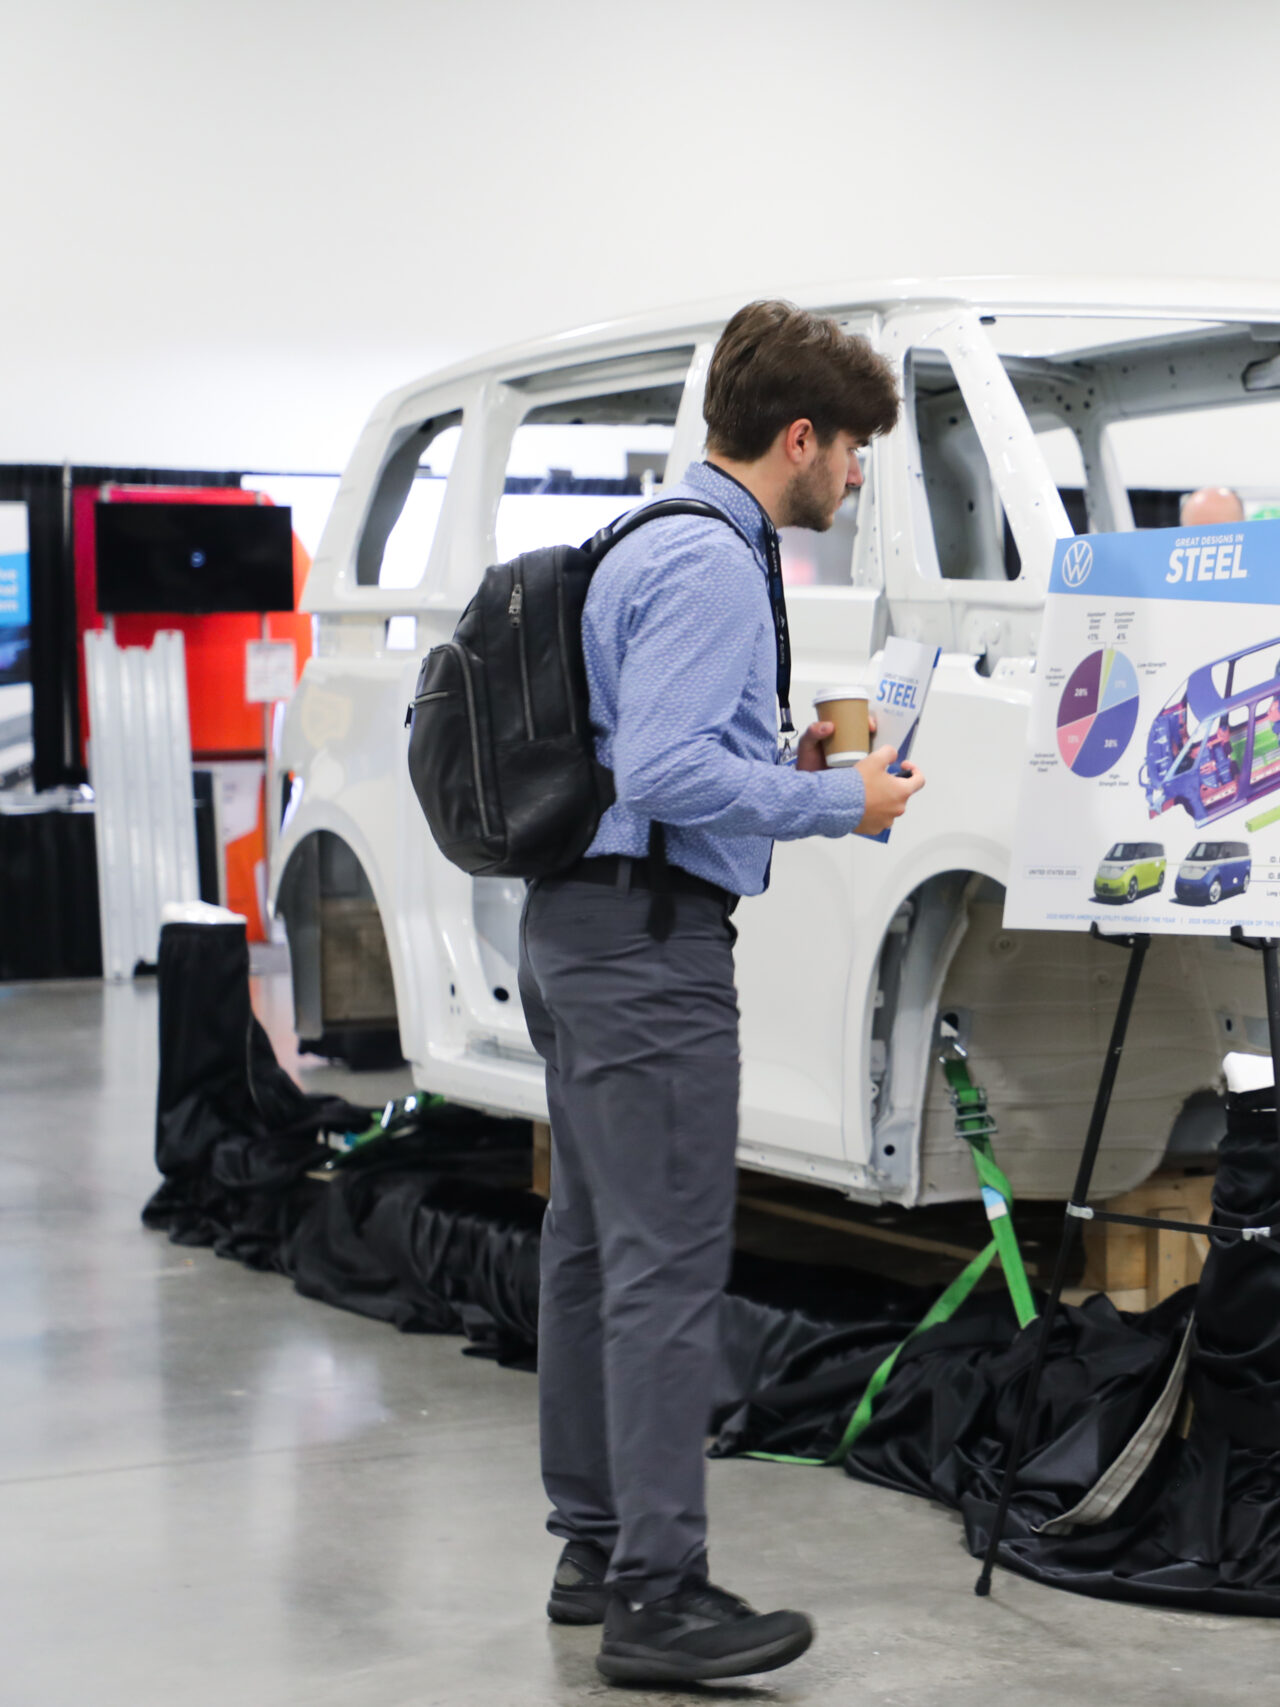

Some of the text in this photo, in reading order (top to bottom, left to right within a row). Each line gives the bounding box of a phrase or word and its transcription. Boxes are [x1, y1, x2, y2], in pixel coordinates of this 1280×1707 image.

[1175, 533, 1244, 547] GREAT DESIGNS IN
[1165, 544, 1248, 584] STEEL
[876, 679, 917, 710] STEEL
